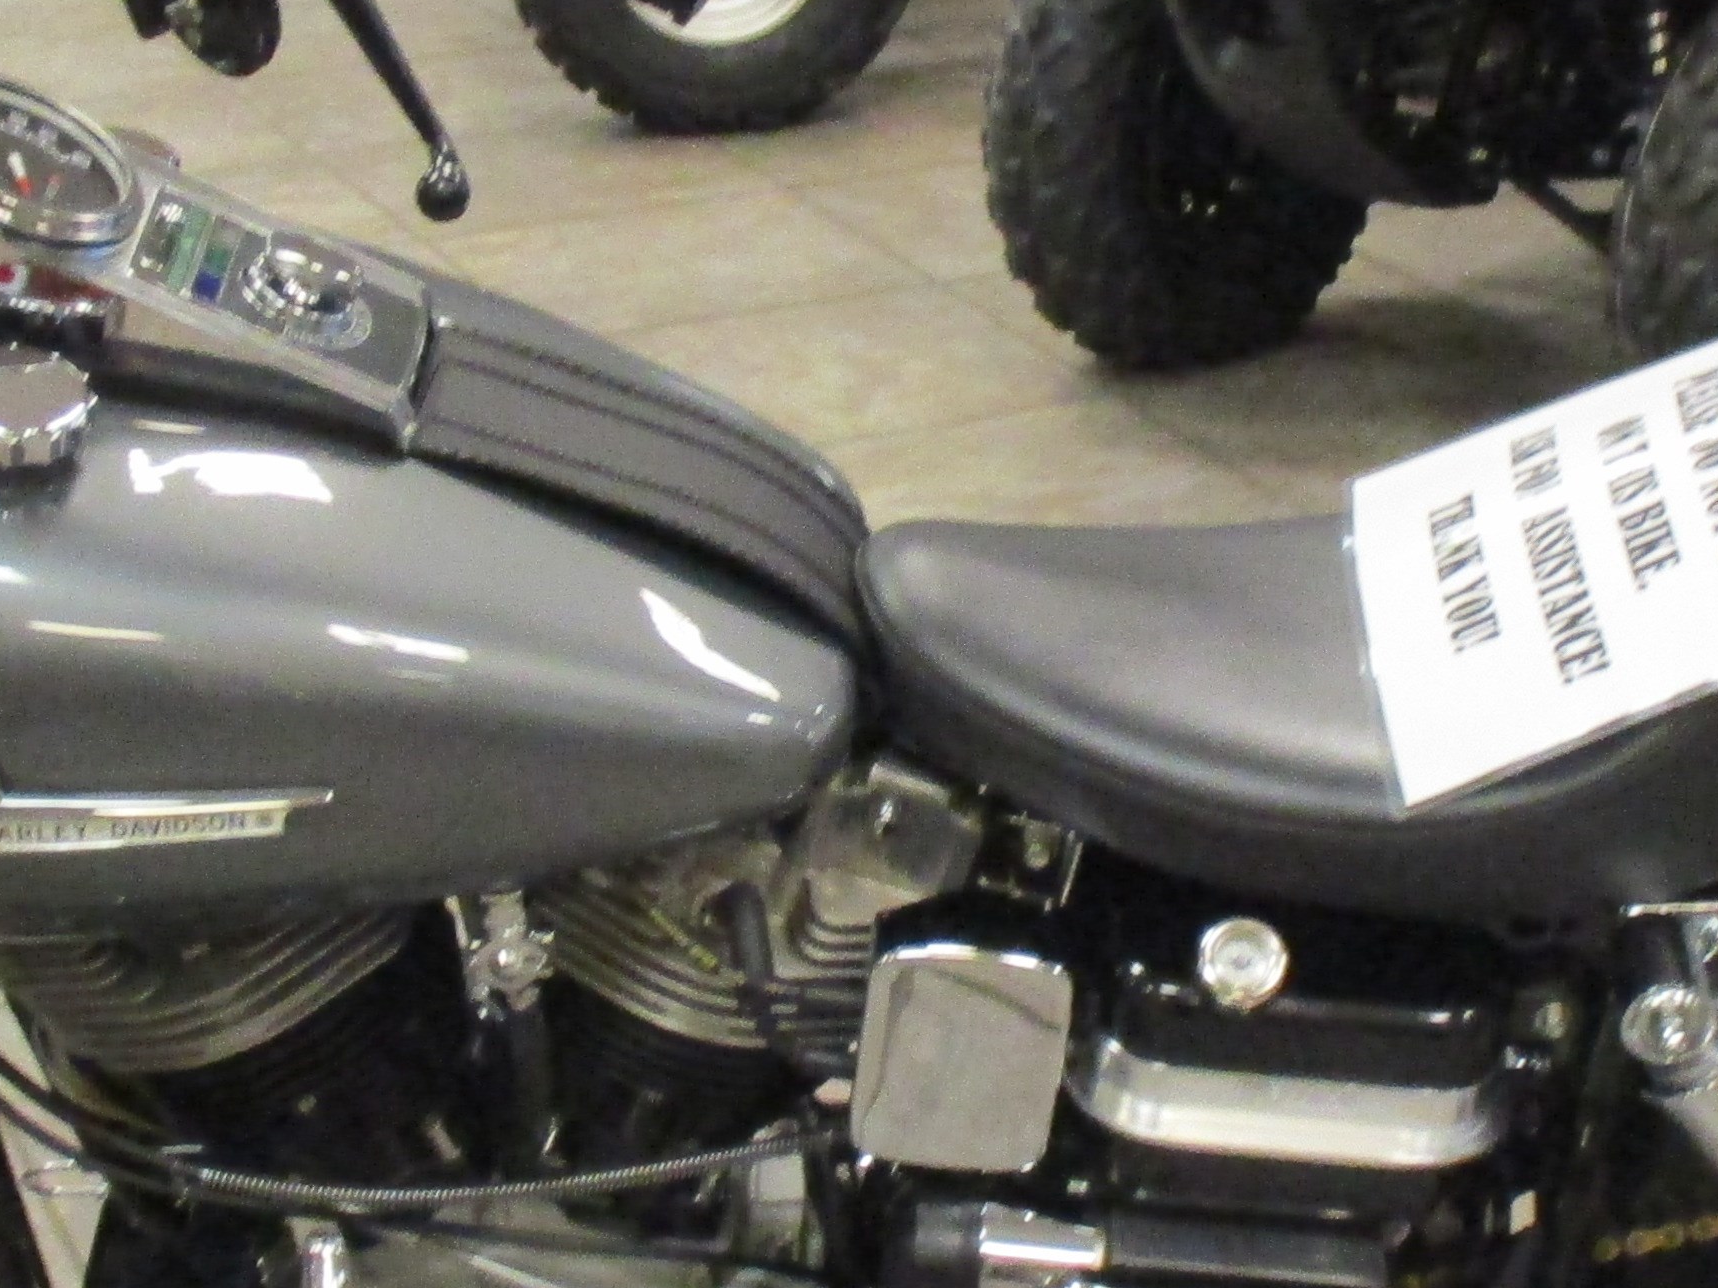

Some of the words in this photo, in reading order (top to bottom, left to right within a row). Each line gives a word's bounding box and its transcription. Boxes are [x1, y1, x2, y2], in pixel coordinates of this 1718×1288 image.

[1617, 495, 1682, 593] BIKE.
[1442, 570, 1502, 654] YOU!
[1520, 503, 1613, 686] ASSISTANCE!
